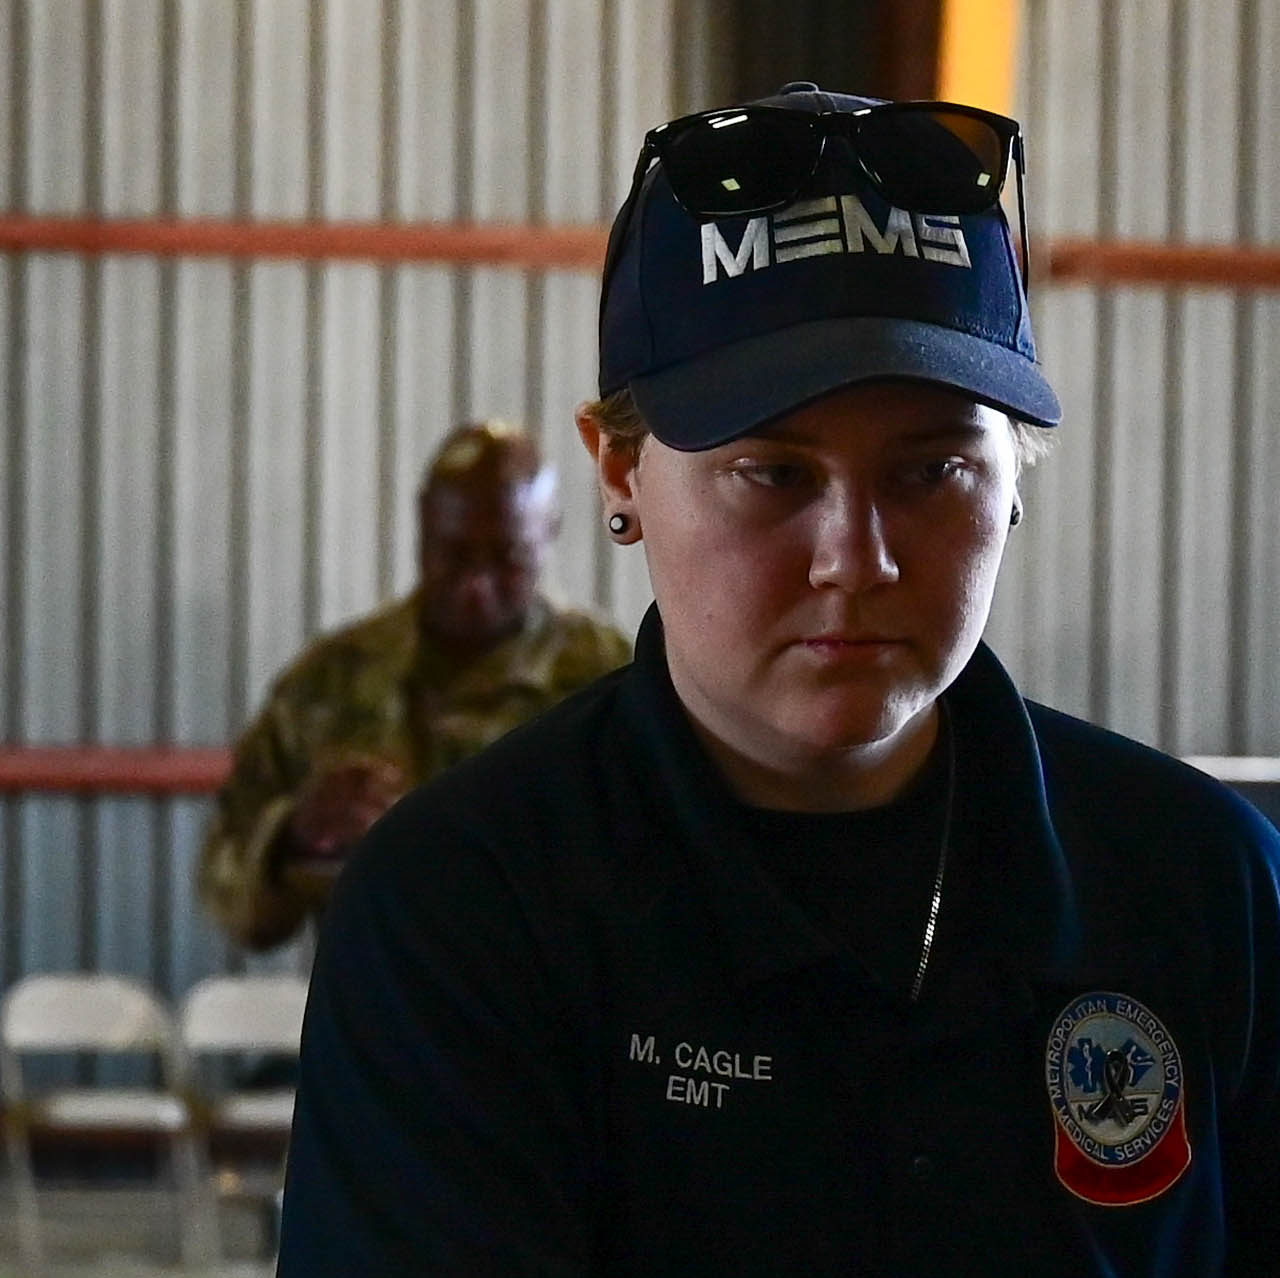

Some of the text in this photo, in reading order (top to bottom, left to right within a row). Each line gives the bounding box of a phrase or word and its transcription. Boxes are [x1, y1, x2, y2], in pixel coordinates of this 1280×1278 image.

[701, 195, 972, 286] MEMS
[628, 1033, 773, 1081] M. CAGLE
[1049, 1000, 1180, 1099] METROPOLITAN EMERGENCY
[665, 1075, 730, 1109] EMT
[1060, 1105, 1109, 1160] MEDICAL
[1114, 1099, 1174, 1160] SERVICES
